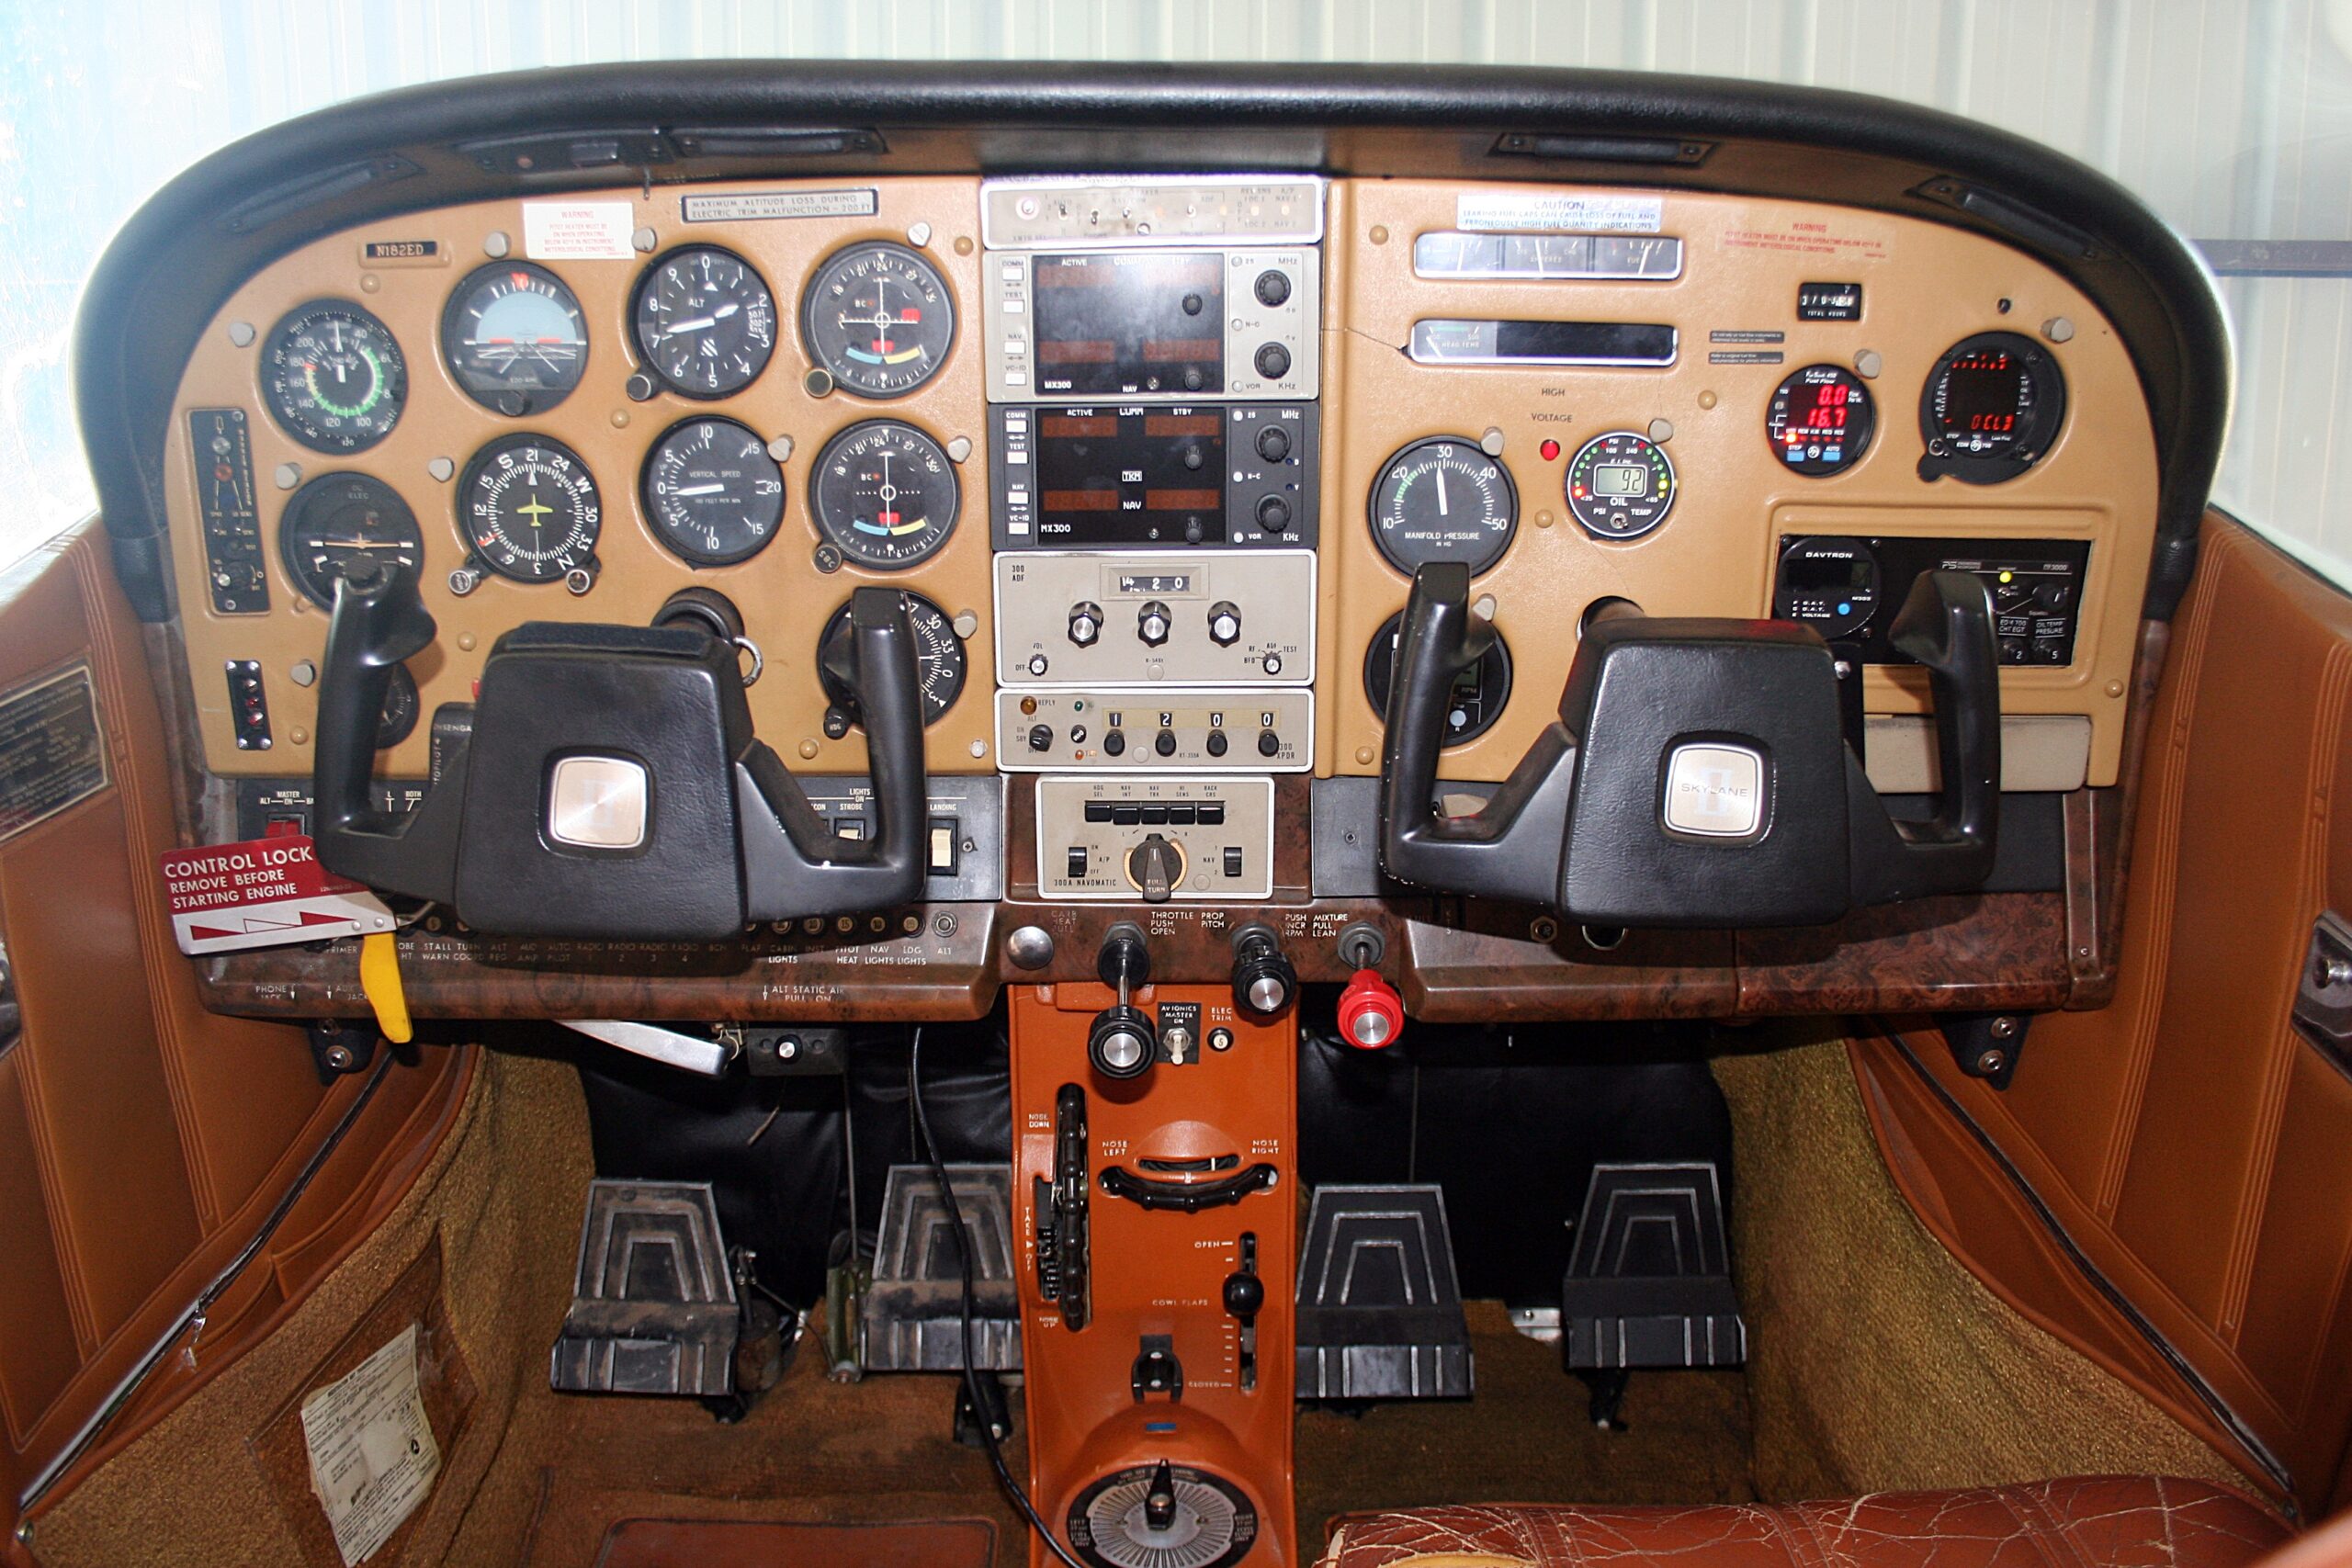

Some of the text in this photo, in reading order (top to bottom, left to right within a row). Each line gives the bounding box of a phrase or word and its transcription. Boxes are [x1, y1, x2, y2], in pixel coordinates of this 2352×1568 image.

[745, 198, 784, 207] ALTITUDE
[821, 195, 857, 203] DURING
[1534, 200, 1585, 210] CAUTION
[693, 209, 731, 219] ELECTRIC
[763, 206, 830, 215] MALFUNCTION
[1792, 223, 1826, 232] WARNING
[376, 244, 424, 256] N182ED
[689, 299, 704, 308] ALT
[1044, 381, 1071, 389] MX300
[299, 399, 314, 408] 140
[1282, 410, 1299, 419] MHz
[1531, 412, 1573, 423] VOLTAGE
[1808, 407, 1848, 428] 16.7
[325, 417, 341, 427] 120
[357, 417, 371, 426] 100
[700, 425, 713, 438] 10
[748, 443, 760, 454] 15
[1437, 446, 1453, 457] 30
[526, 449, 538, 461] 21
[552, 456, 570, 471] 24
[1480, 467, 1497, 479] 40
[1622, 469, 1642, 491] 92
[766, 481, 781, 492] 20
[1123, 502, 1141, 510] NAV
[1610, 498, 1627, 506] OIL
[474, 504, 487, 516] 12
[585, 506, 597, 523] 30
[1041, 524, 1070, 533] MX300
[1383, 518, 1395, 529] 10
[1491, 519, 1507, 531] 50
[752, 524, 763, 535] 15
[1283, 533, 1299, 541] KHz
[707, 537, 719, 549] 10
[1681, 784, 1748, 796] SKYLANE
[164, 845, 313, 879] CONTROL LOCK
[170, 869, 285, 894] REMOVE BEFORE
[173, 890, 240, 909] STARTING
[246, 883, 298, 899] ENGINE
[865, 956, 894, 964] LIGHTS
